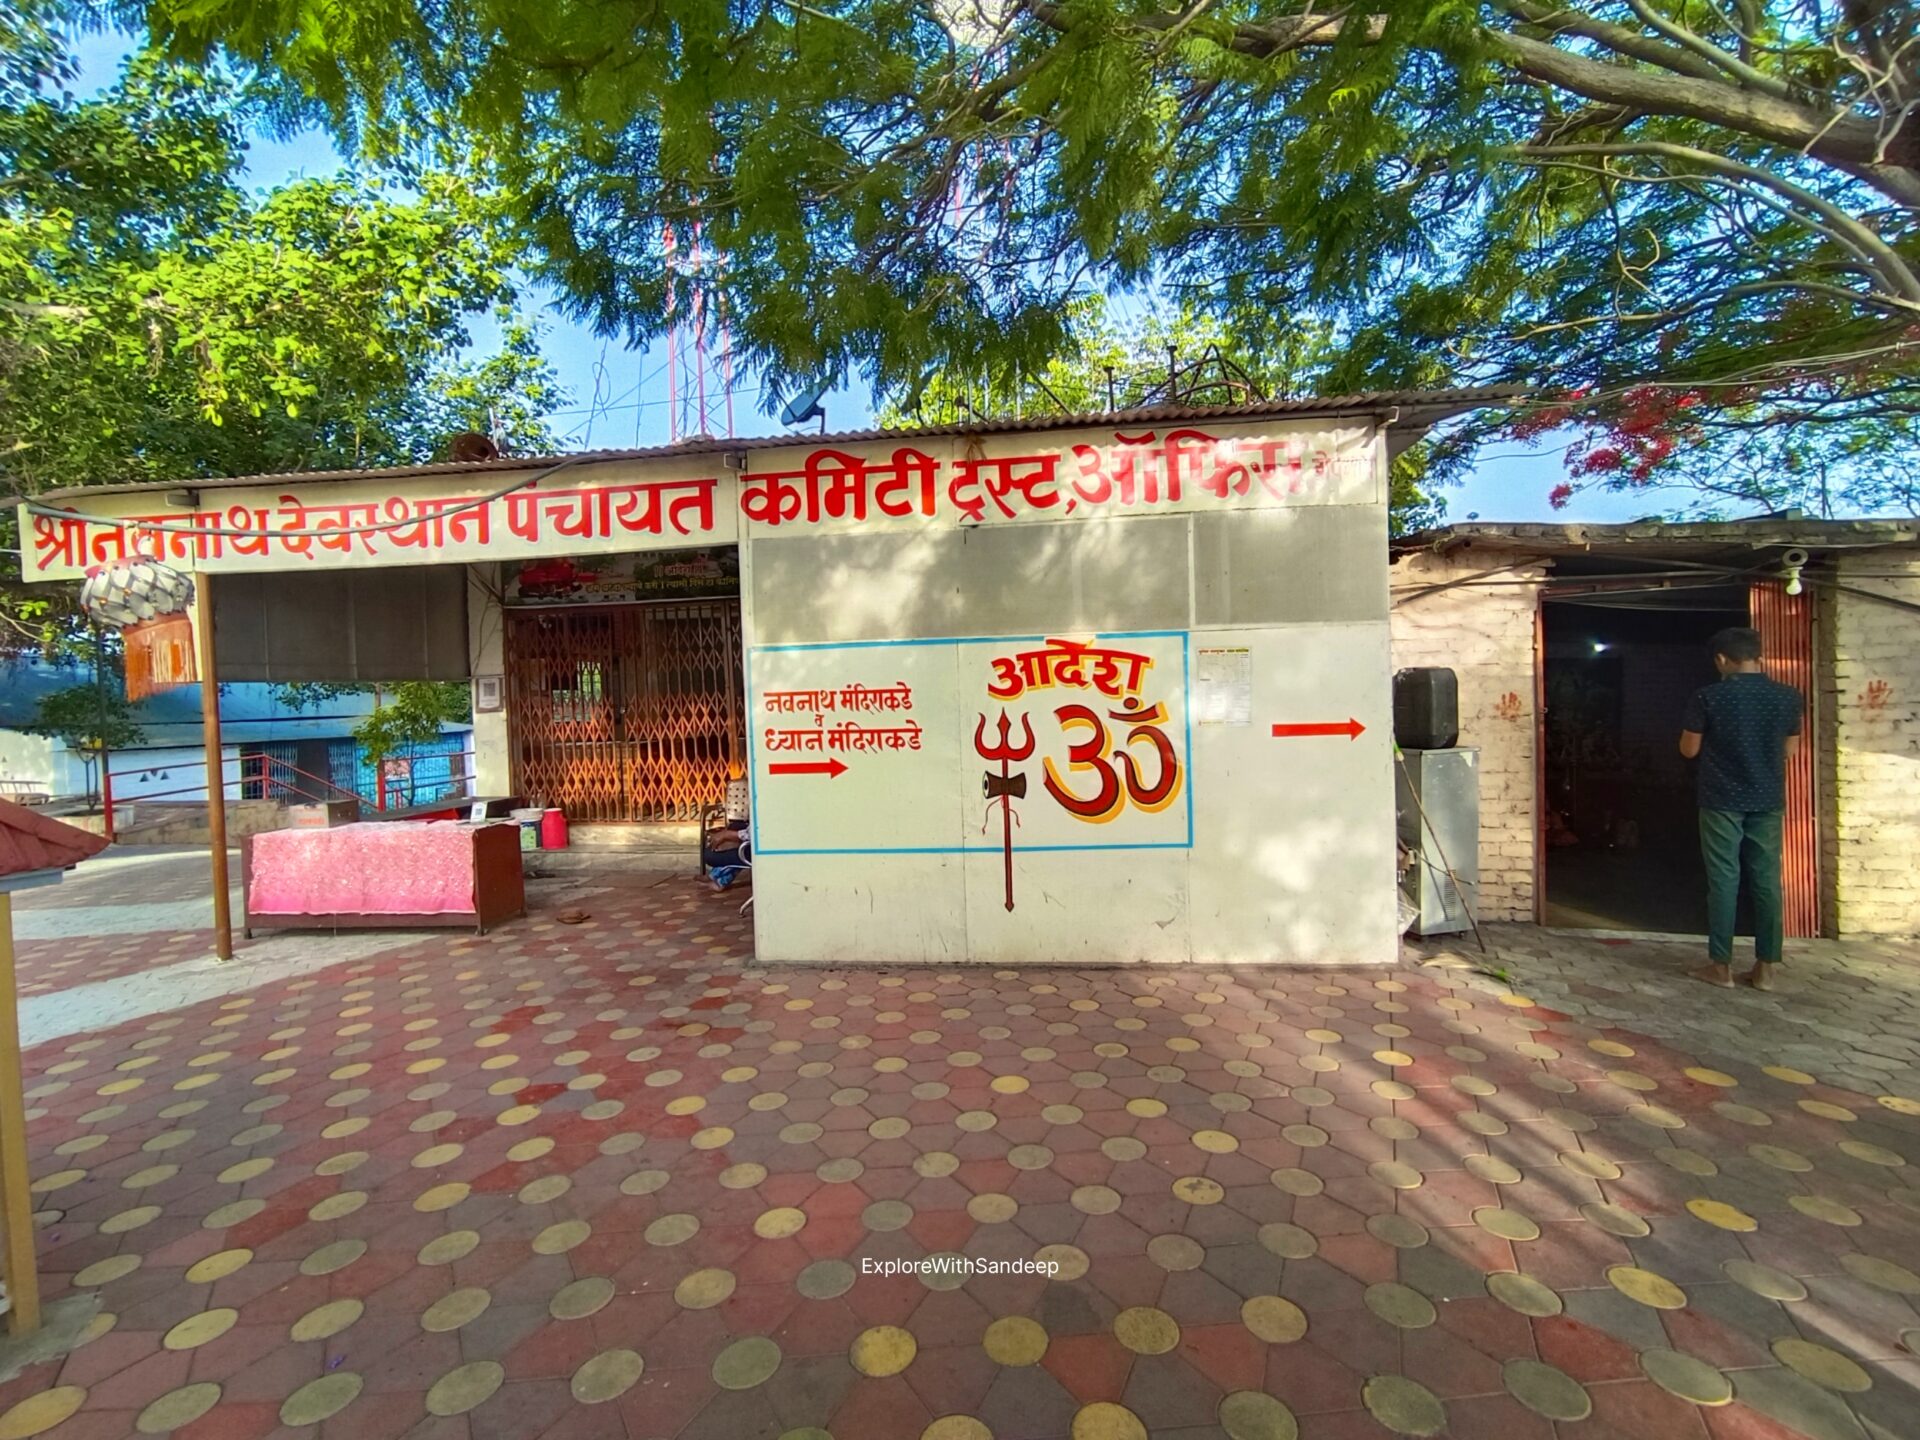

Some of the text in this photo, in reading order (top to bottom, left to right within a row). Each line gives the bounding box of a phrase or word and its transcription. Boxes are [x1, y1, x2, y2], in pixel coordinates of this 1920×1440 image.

[740, 448, 941, 525] कमिटी
[988, 639, 1154, 700] आदेश
[763, 681, 913, 714] नवनाथ मंदिराकडे
[764, 719, 923, 753] ध्यान मंदिराकडे
